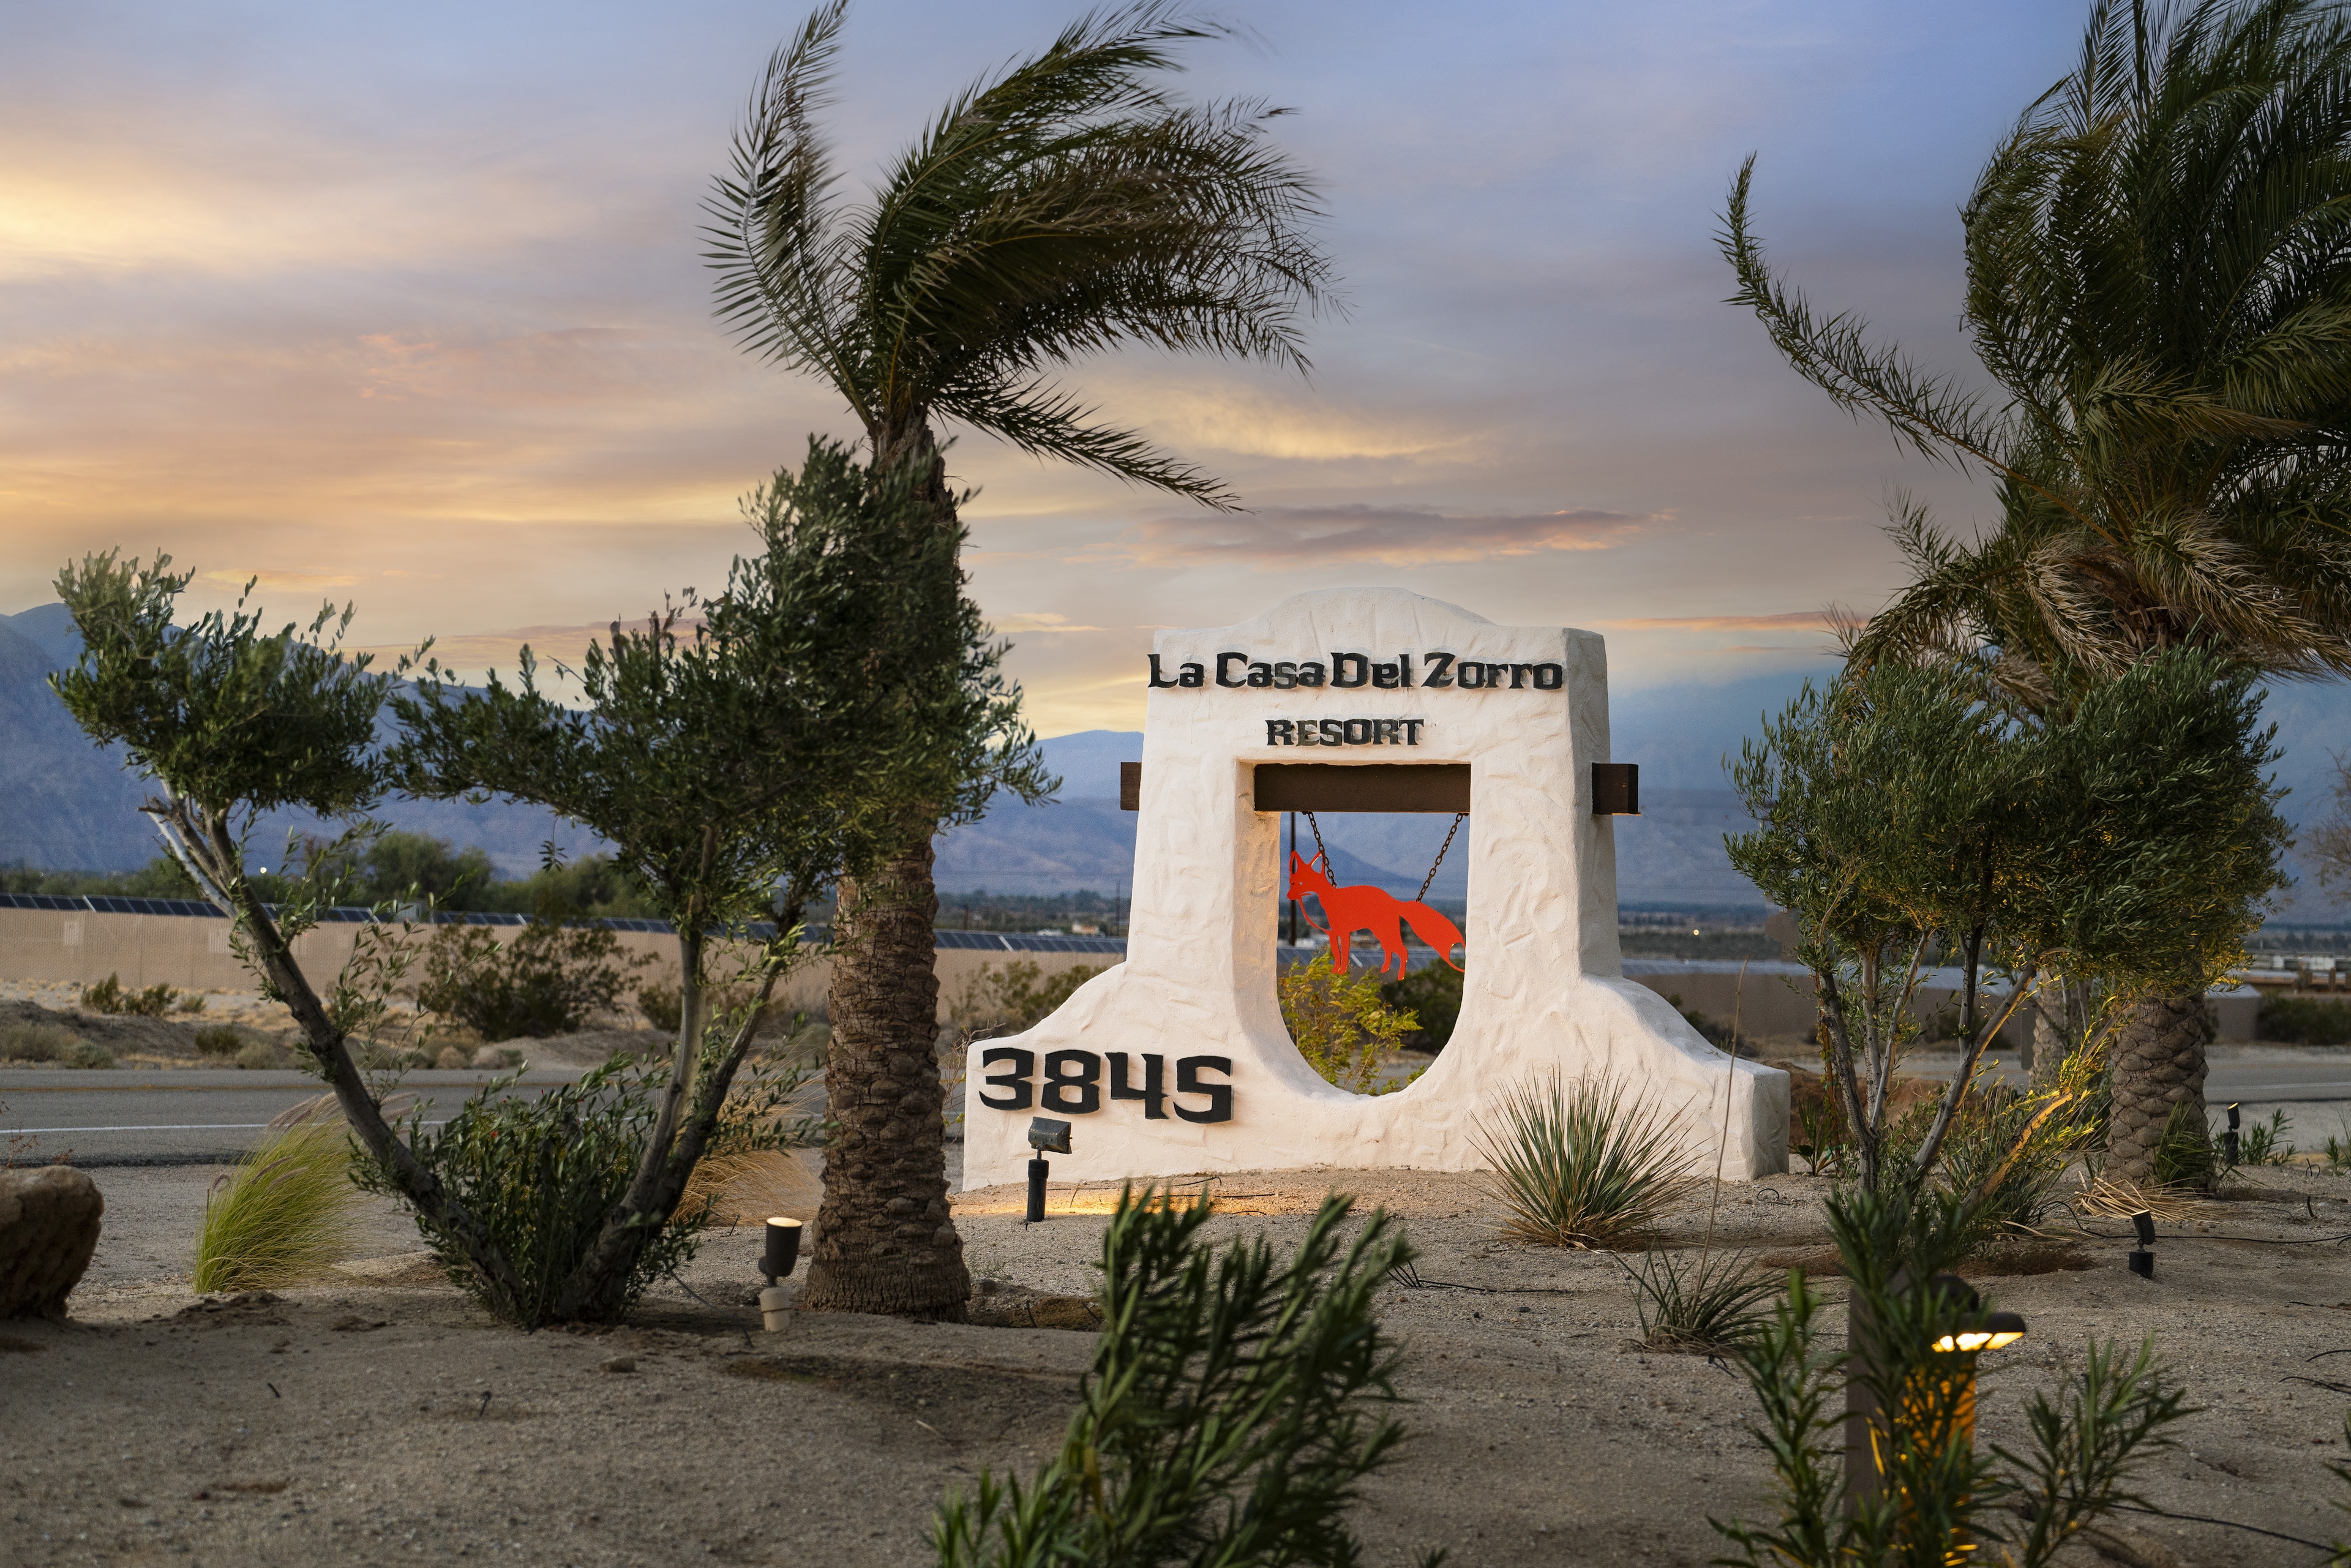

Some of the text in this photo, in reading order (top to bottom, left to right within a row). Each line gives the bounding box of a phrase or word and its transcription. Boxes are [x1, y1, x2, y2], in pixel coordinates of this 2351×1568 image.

[1147, 651, 1563, 690] La Casa Del Zorro
[1265, 718, 1425, 747] RESORT
[979, 1047, 1234, 1124] 3845
